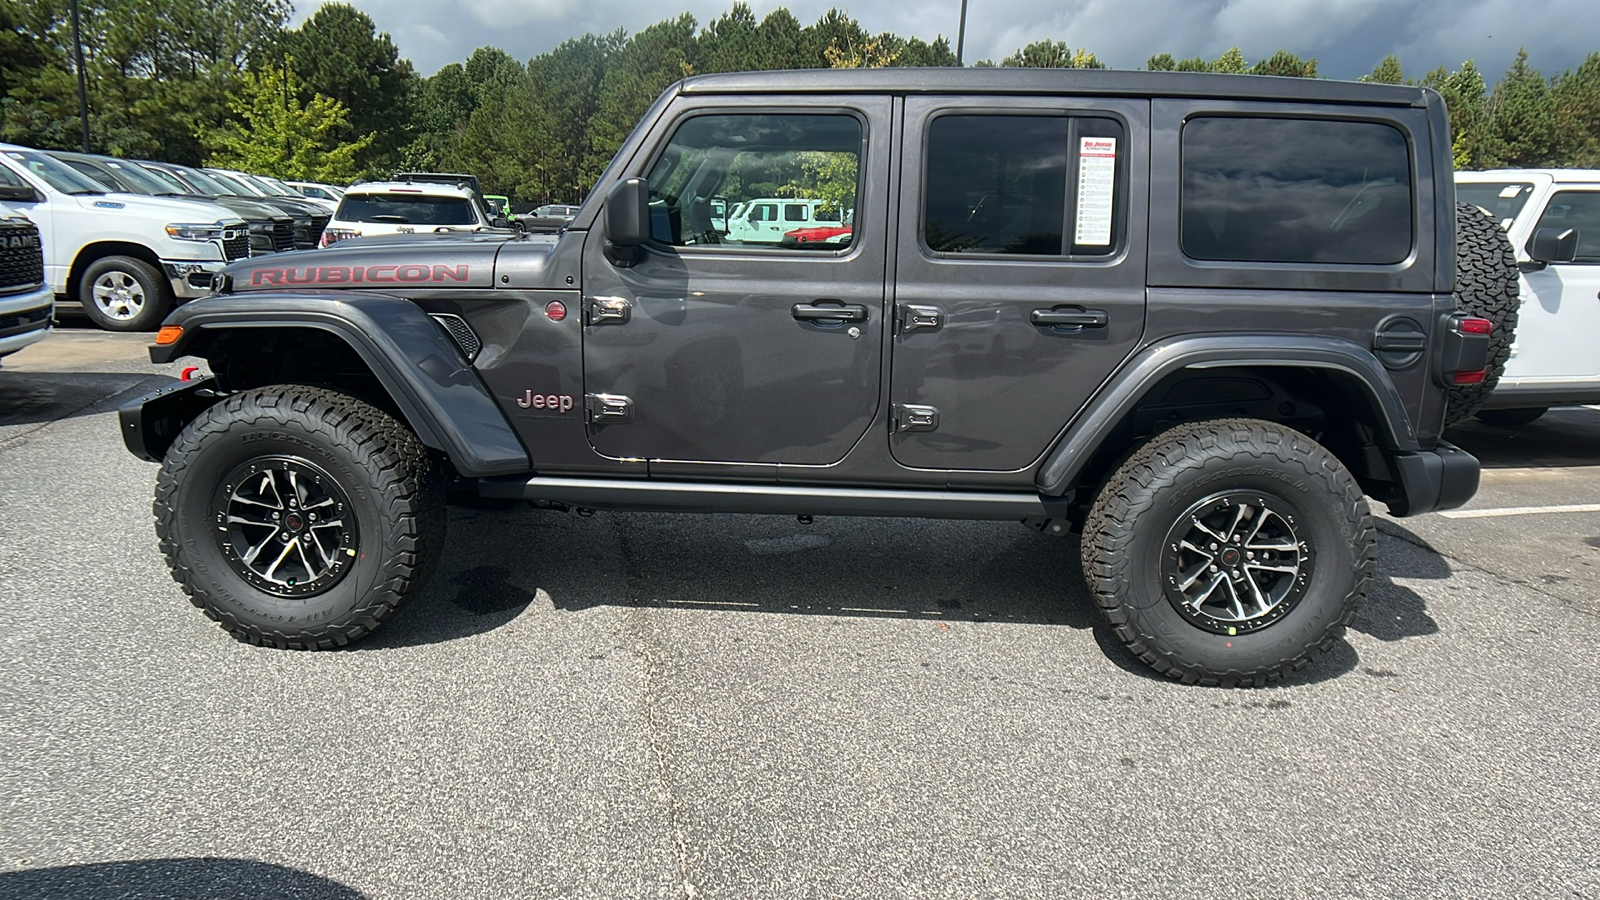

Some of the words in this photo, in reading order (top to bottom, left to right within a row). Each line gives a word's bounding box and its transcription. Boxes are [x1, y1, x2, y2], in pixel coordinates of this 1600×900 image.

[0, 235, 33, 248] RAM
[250, 264, 469, 286] RUBICON
[516, 389, 573, 414] Jeep
